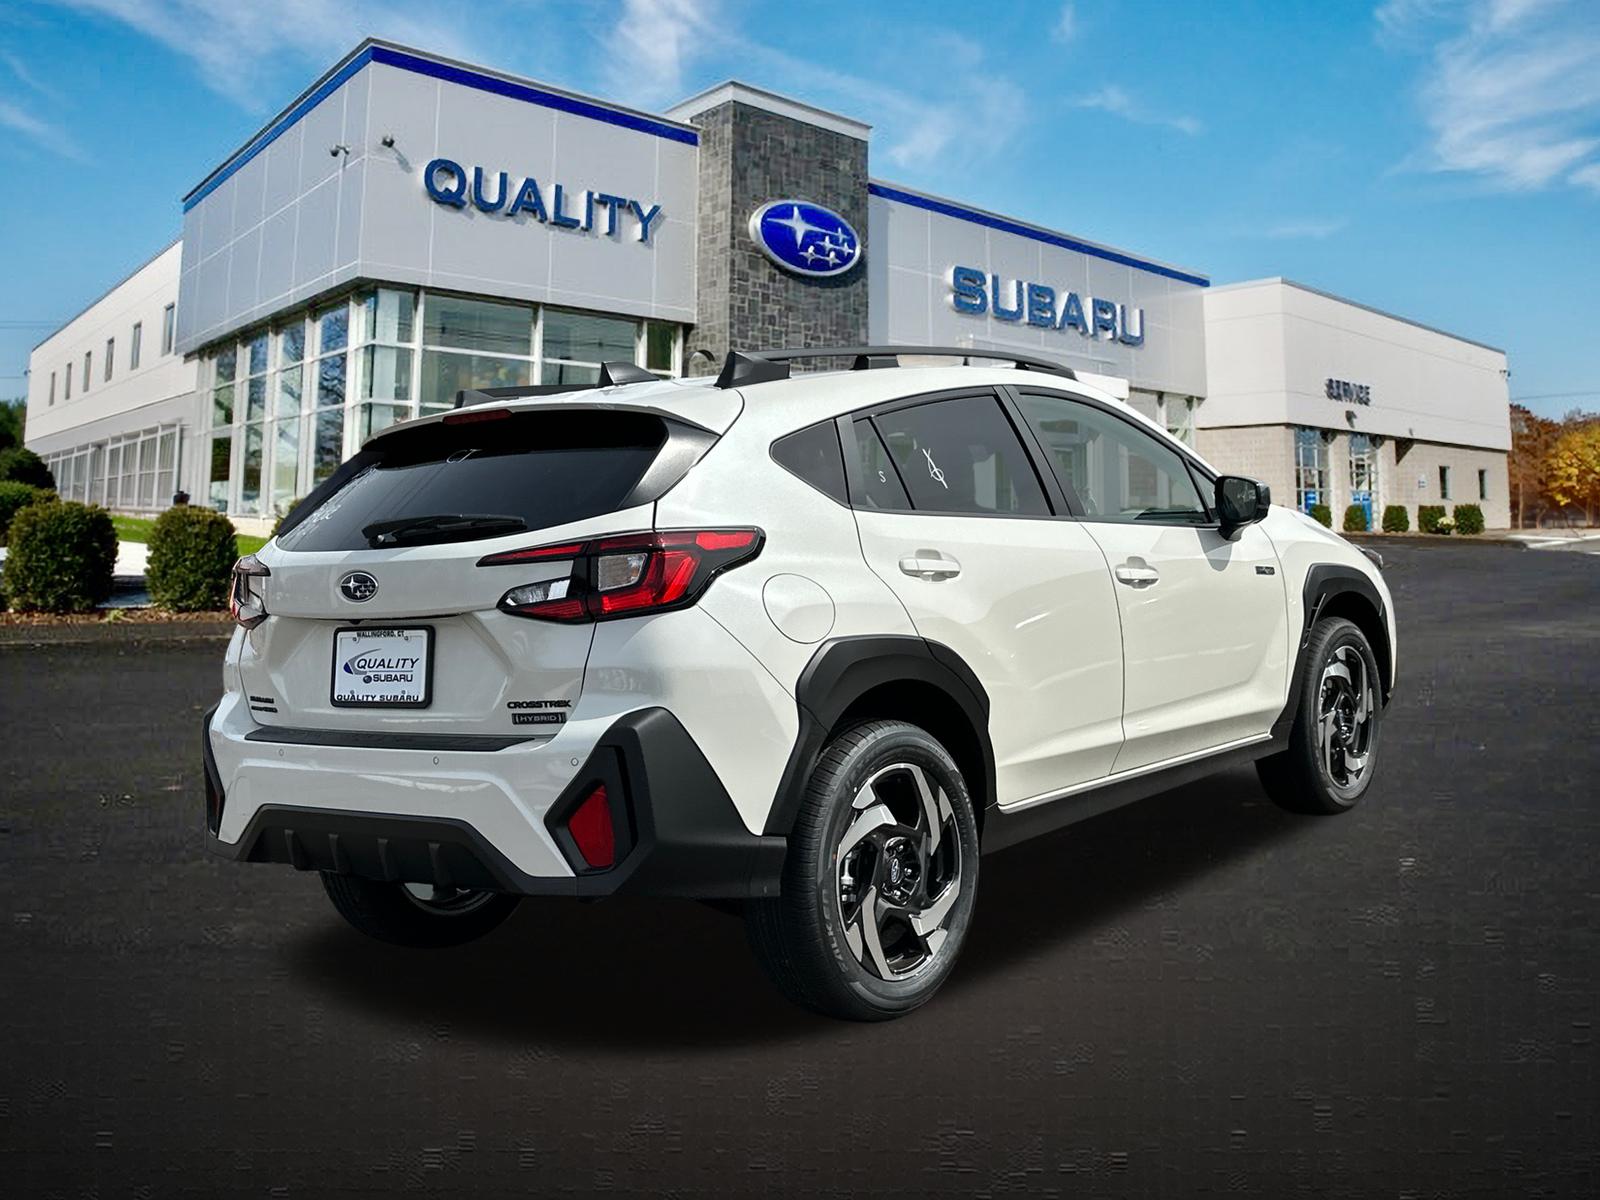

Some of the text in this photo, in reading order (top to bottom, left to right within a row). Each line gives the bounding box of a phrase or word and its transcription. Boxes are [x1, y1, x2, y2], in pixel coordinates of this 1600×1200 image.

[424, 159, 661, 242] QUALITY
[952, 265, 1144, 346] SUBARU
[1325, 378, 1370, 406] SERVICE
[357, 658, 419, 669] QUALITY
[373, 674, 413, 683] SUBARU
[507, 700, 571, 709] CROSSTREK
